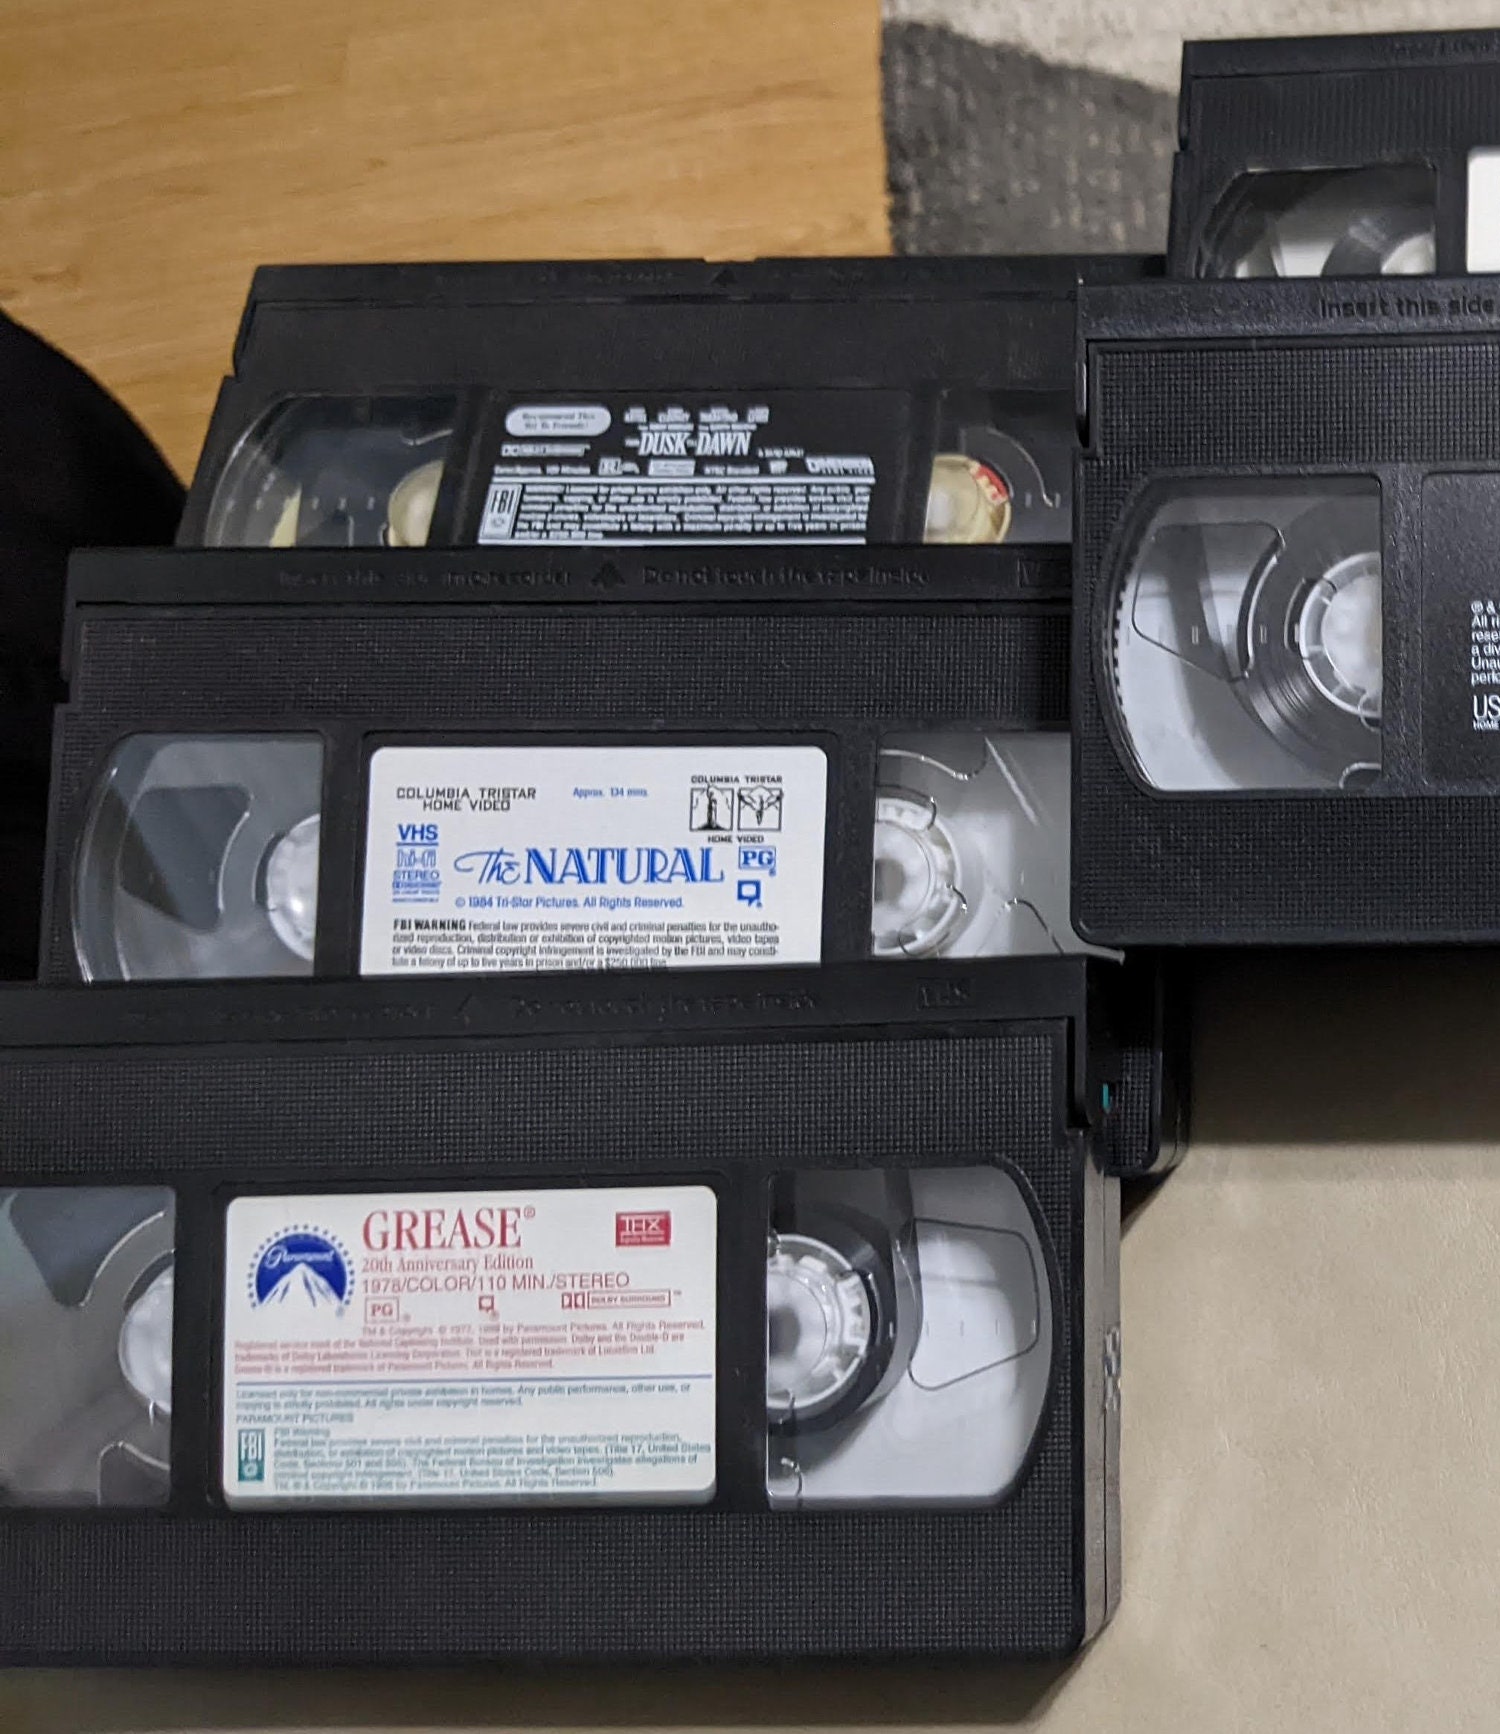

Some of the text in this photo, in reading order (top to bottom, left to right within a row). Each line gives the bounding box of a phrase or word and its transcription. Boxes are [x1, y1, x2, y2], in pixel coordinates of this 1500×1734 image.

[639, 431, 690, 456] DUSK
[695, 431, 751, 456] DAWN
[1471, 616, 1488, 628] All
[1471, 646, 1480, 656] a
[1473, 719, 1500, 731] HOME
[691, 774, 783, 784] COLUMBIA TRISTAR
[396, 786, 537, 800] COLUMBIA TRISTAR
[423, 799, 511, 812] HOME VIDEO
[398, 823, 439, 842] VHS
[707, 834, 765, 844] HOME VIDEO
[740, 849, 776, 866] PG
[454, 847, 725, 886] The NATURAL
[393, 870, 440, 881] STEREO
[468, 895, 493, 908] 1984
[583, 894, 597, 908] All
[599, 894, 632, 910] Rights
[634, 895, 684, 908] Reserved.
[393, 918, 412, 931] FBI
[415, 918, 466, 931] WARNING
[611, 921, 628, 932] and
[709, 921, 721, 932] for
[362, 1253, 534, 1277] 20th Anniversary Edition
[362, 1271, 630, 1295] 1978/COLOR/110 MIN./STEREO
[370, 1305, 394, 1317] PG
[240, 1431, 263, 1461] FBI
